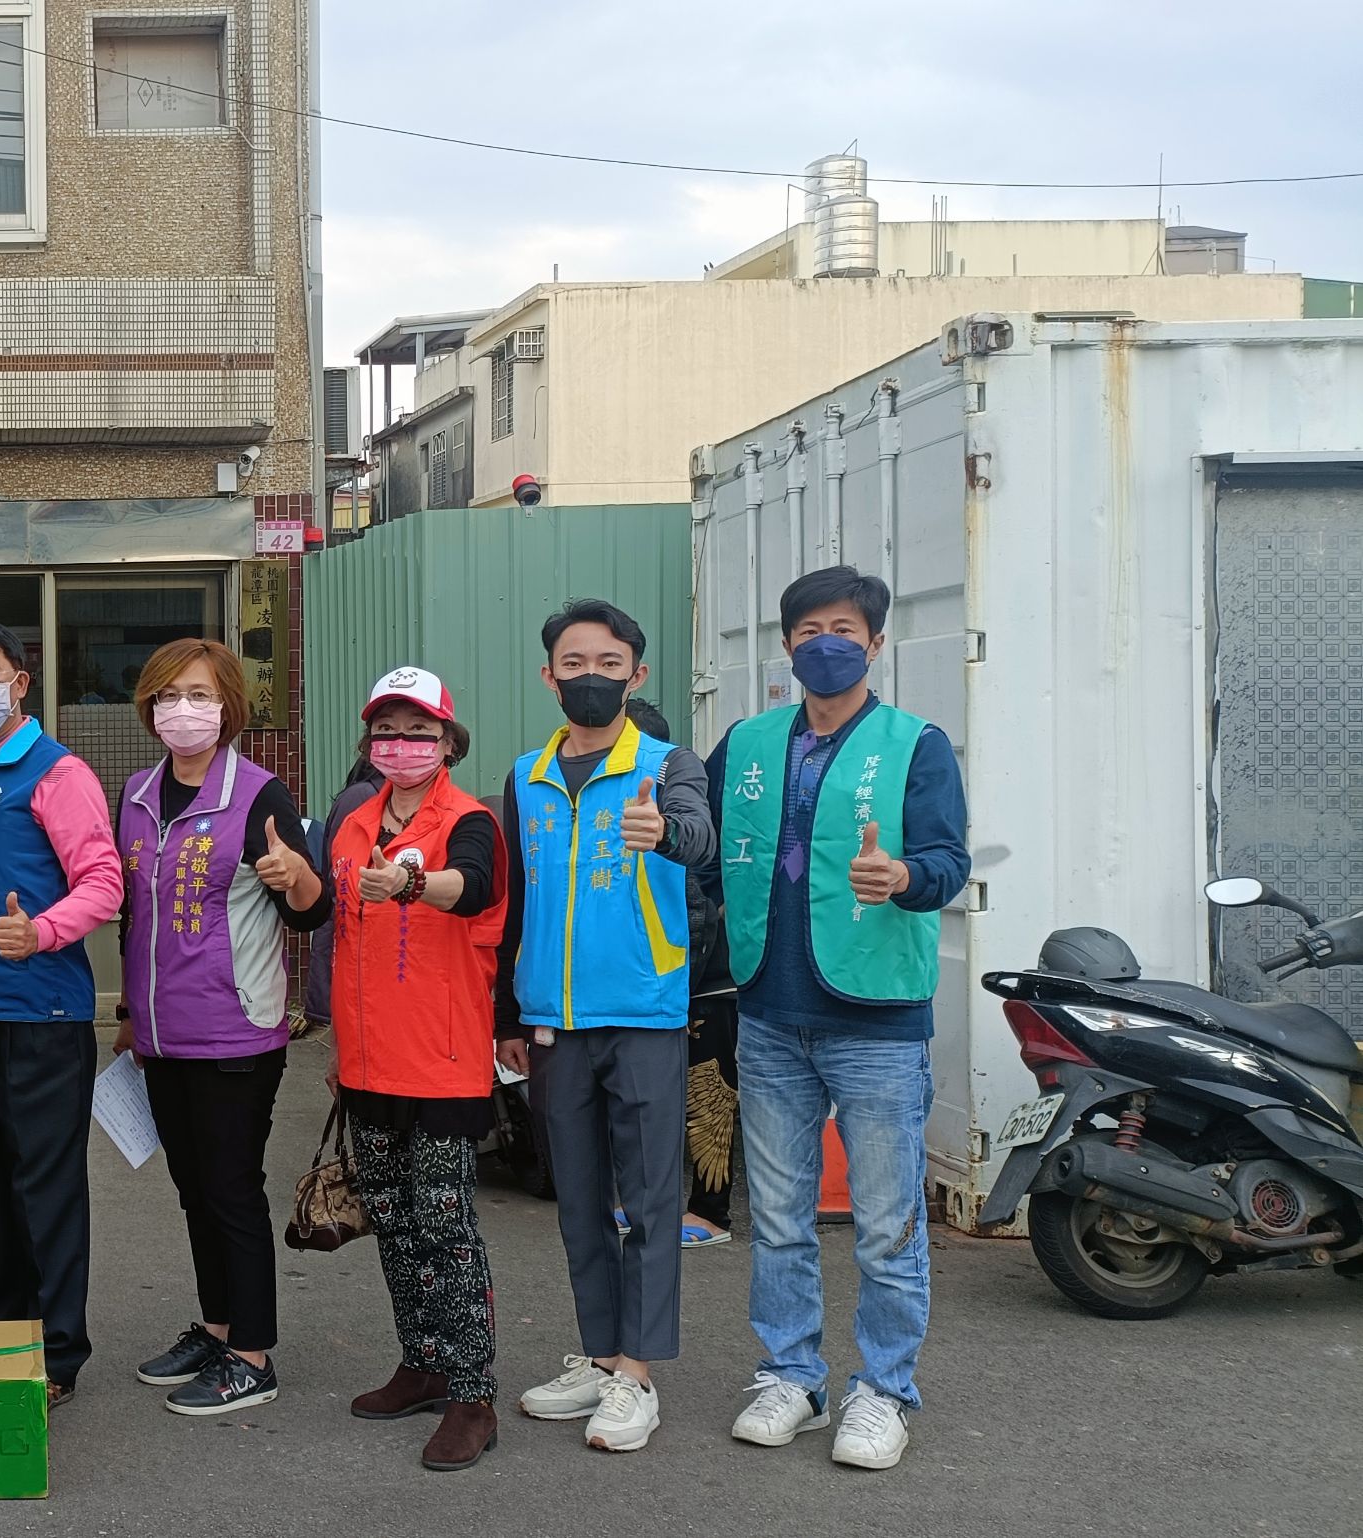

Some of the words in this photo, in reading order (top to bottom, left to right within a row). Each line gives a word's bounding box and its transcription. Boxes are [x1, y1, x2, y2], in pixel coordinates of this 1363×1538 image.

[270, 534, 294, 550] 42
[250, 566, 264, 604] 龍潭區
[267, 566, 279, 603] 桃園市
[256, 608, 274, 724] 凌辦公處
